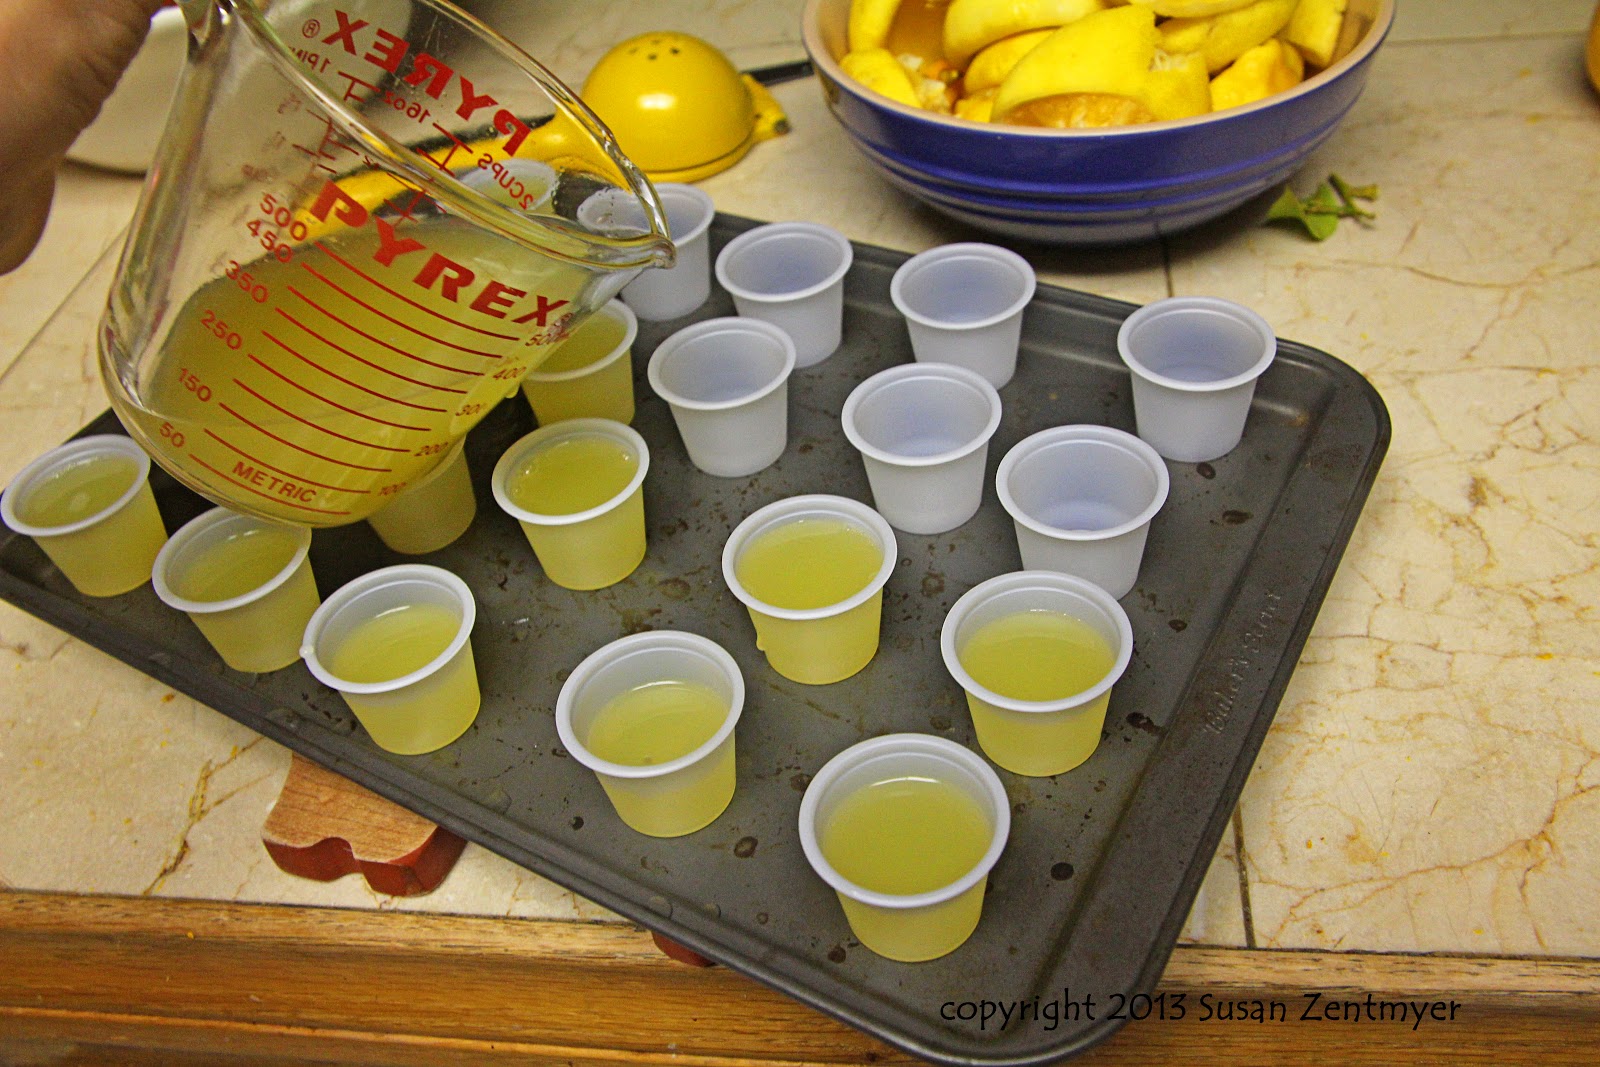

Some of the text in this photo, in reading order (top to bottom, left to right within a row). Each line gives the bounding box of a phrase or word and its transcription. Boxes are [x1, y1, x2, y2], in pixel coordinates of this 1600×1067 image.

[259, 193, 308, 241] 500
[246, 218, 294, 263] 450
[310, 179, 571, 328] PYREX
[225, 260, 270, 304] 350
[201, 309, 243, 350] 250
[178, 368, 212, 402] 150
[159, 422, 185, 448] 50
[232, 461, 317, 502] METRIC
